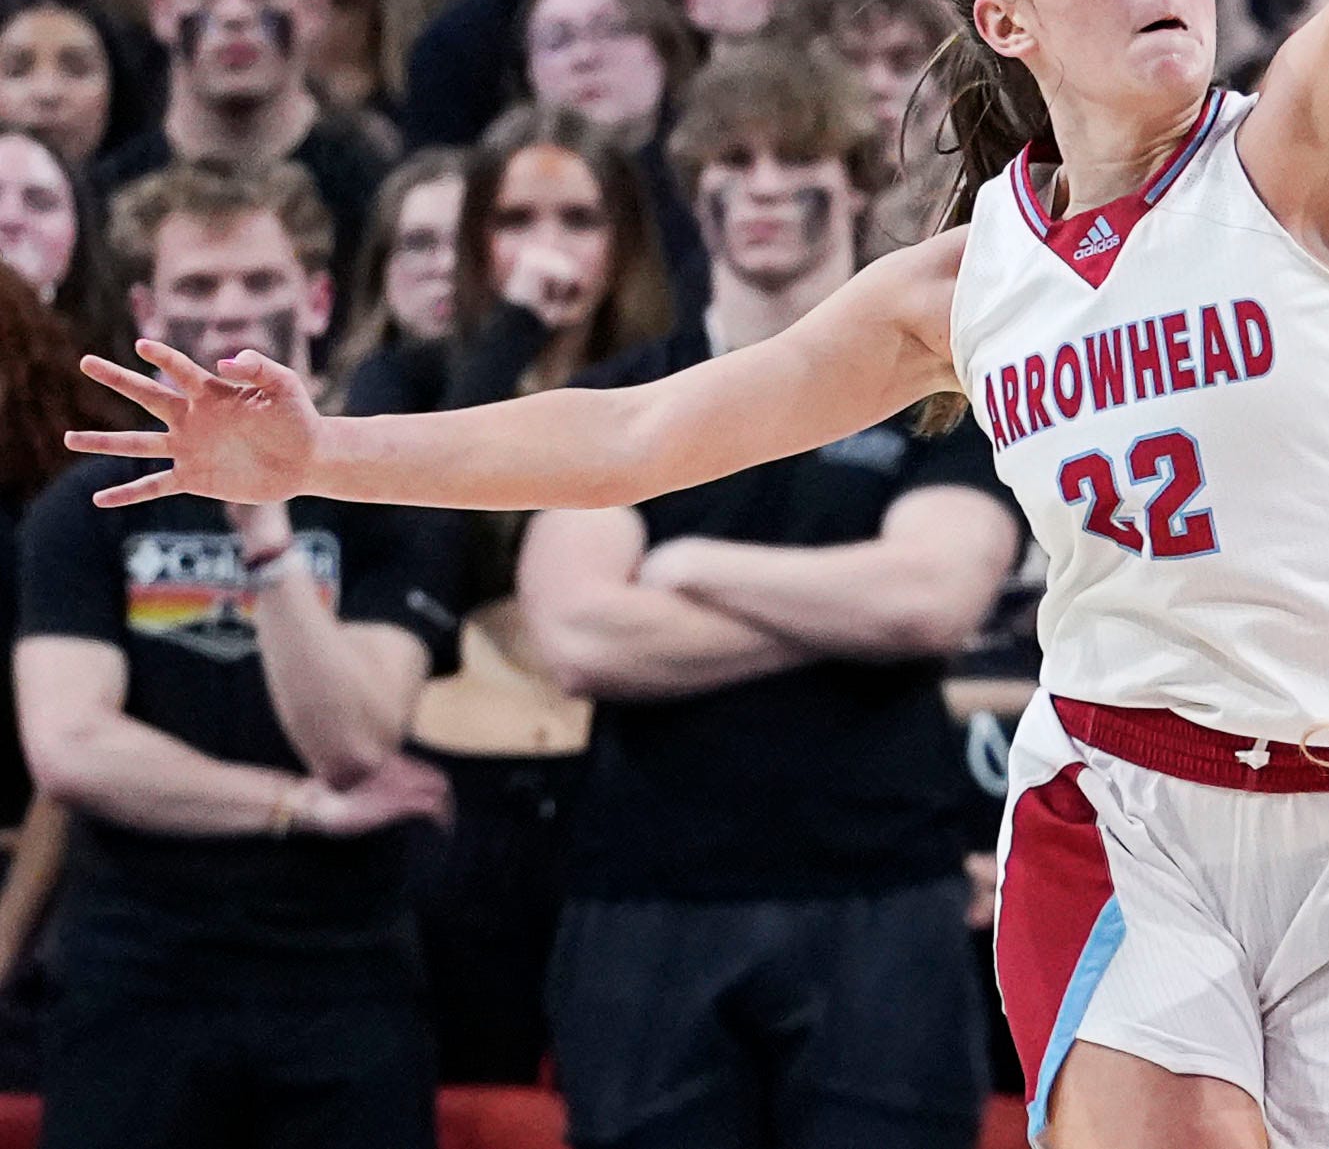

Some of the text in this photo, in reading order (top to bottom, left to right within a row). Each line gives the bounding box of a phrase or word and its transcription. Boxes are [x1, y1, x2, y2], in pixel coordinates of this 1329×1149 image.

[1073, 234, 1121, 262] adidas
[980, 297, 1274, 453] ARROWHEAD
[1057, 427, 1220, 560] 22
